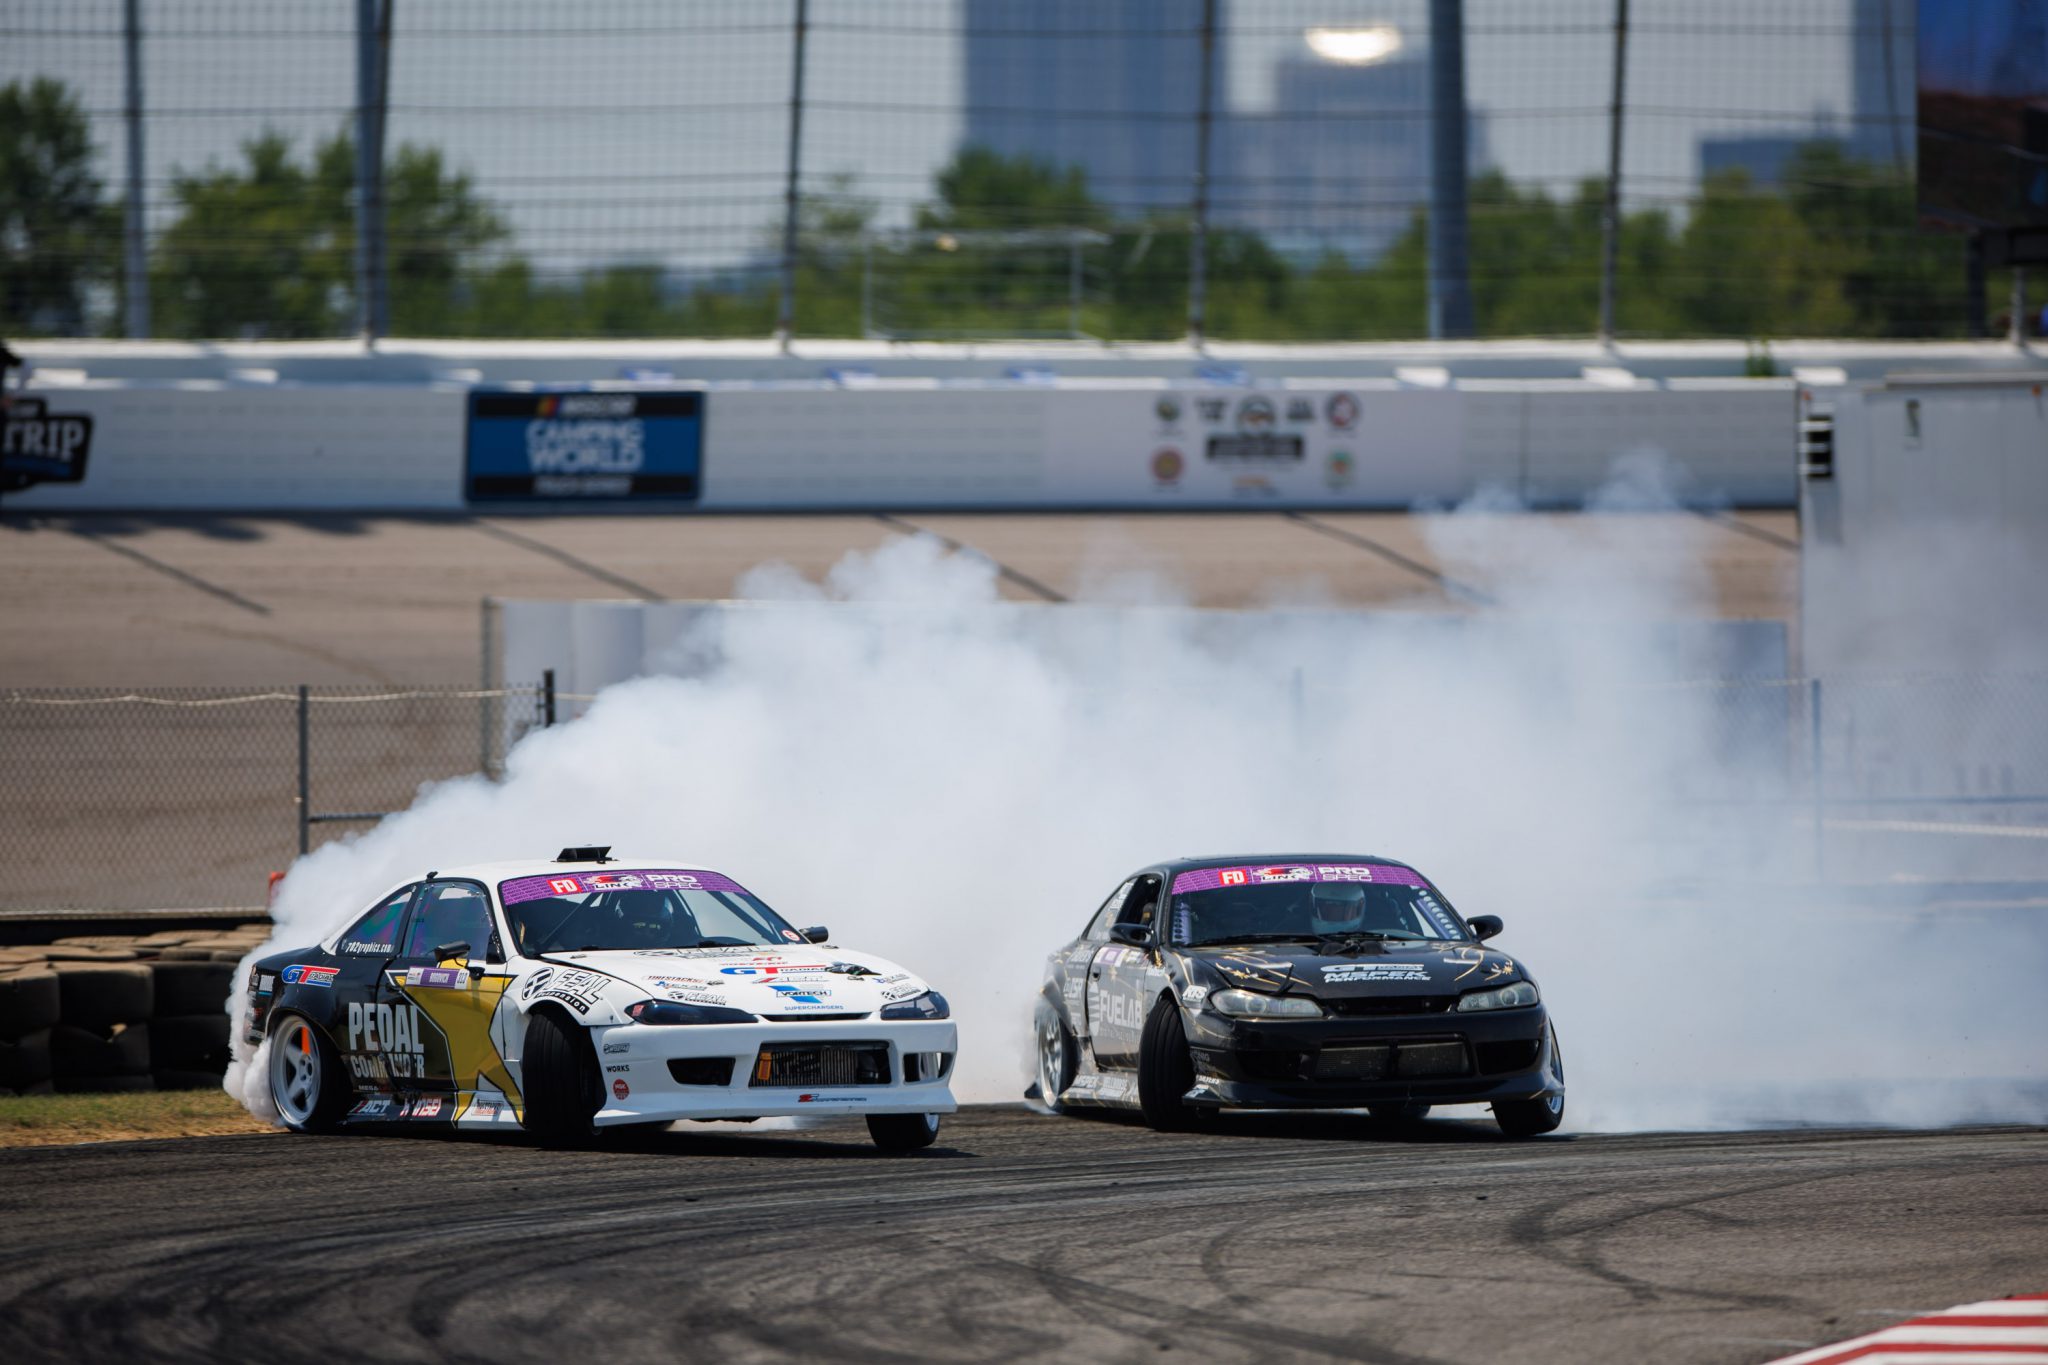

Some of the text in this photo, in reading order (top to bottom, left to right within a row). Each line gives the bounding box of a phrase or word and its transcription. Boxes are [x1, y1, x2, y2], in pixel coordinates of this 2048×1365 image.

[526, 419, 644, 447] CAMPING
[529, 447, 643, 473] WORLD
[1318, 867, 1370, 875] PRO
[649, 874, 698, 883] PRO
[1222, 870, 1244, 884] FD
[1322, 874, 1372, 882] SPEC
[552, 879, 577, 893] FD
[653, 882, 703, 890] SPEC
[281, 964, 340, 985] GT
[1324, 971, 1428, 979] MSPEK
[348, 1002, 424, 1053] PEDAL
[605, 1064, 631, 1073] WORKS
